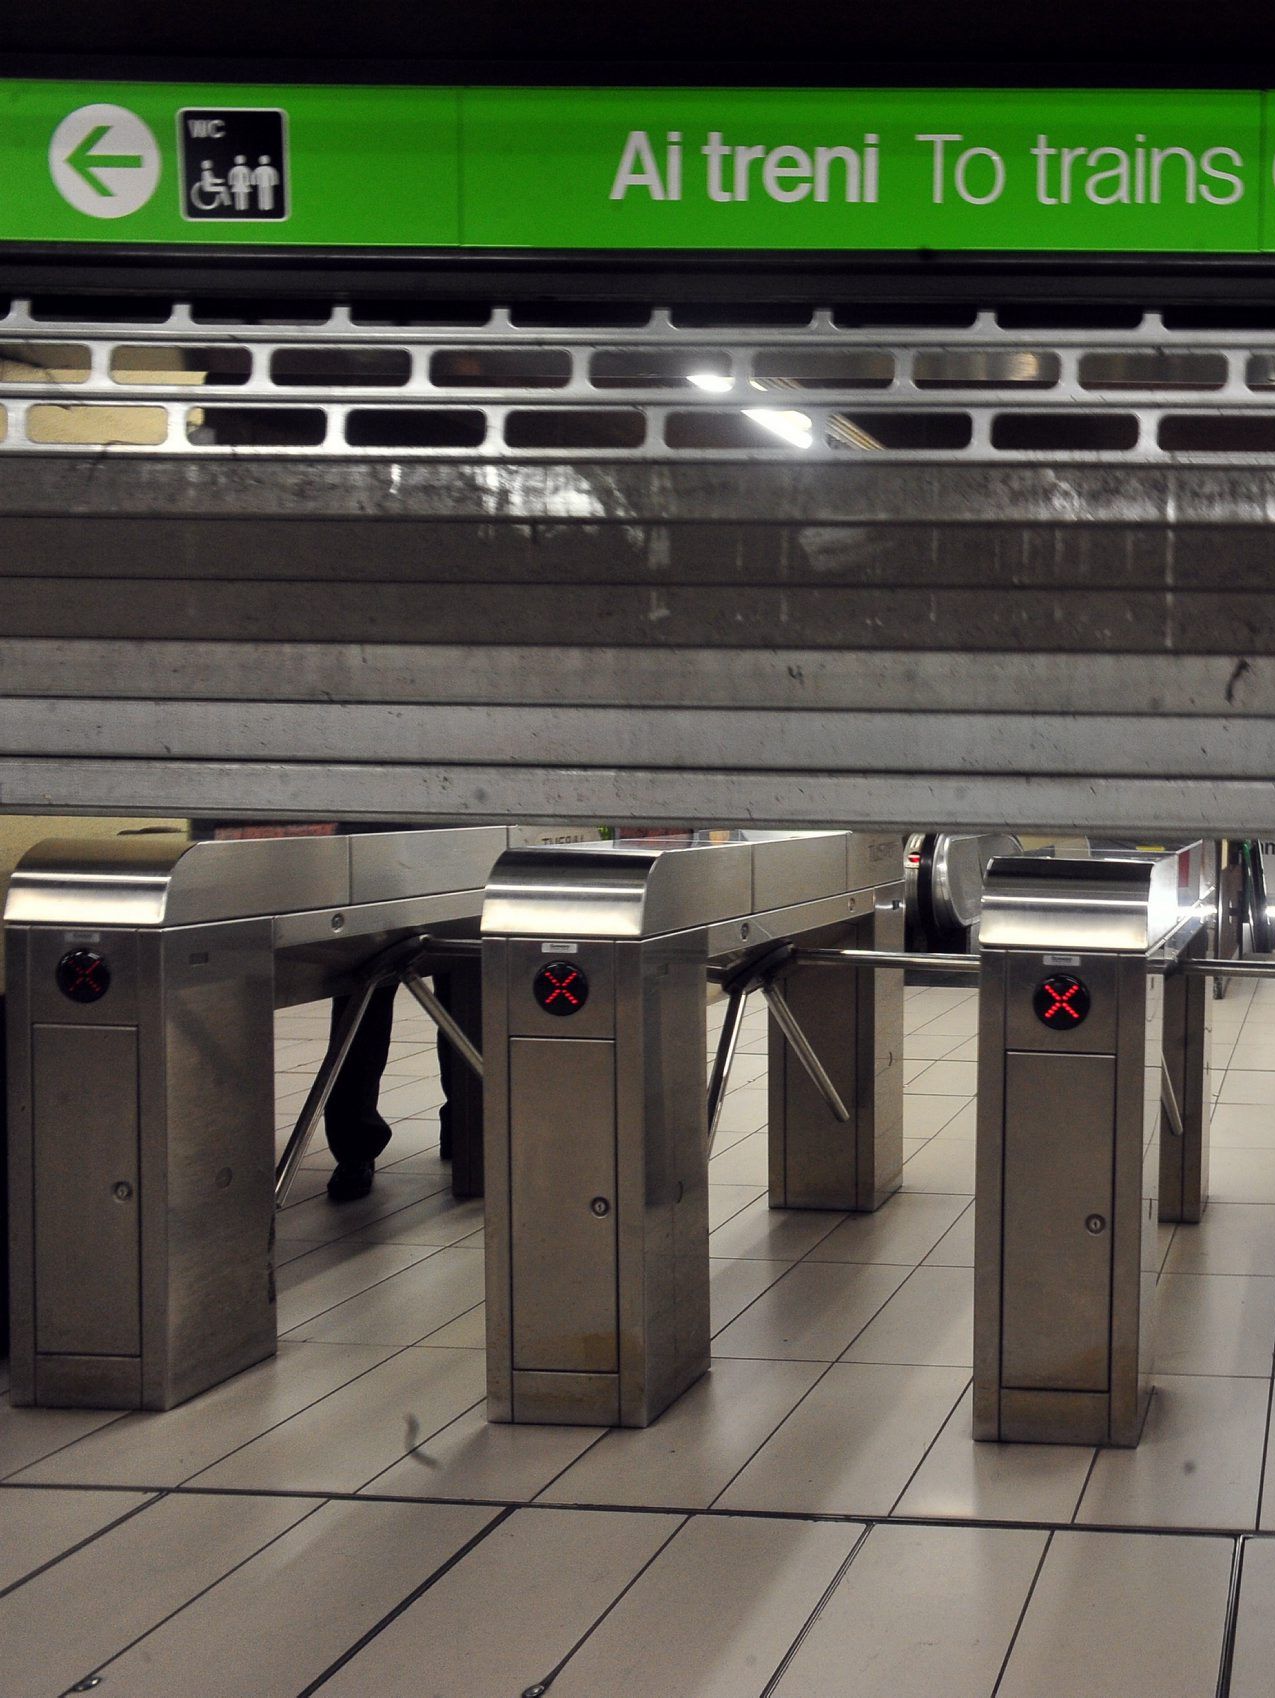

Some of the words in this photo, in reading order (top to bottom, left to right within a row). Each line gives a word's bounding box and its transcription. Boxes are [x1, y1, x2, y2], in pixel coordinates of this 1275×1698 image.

[187, 119, 226, 138] WC
[609, 130, 682, 201] Ai
[701, 131, 879, 203] treni
[915, 134, 1006, 205] To
[1030, 134, 1245, 205] trains
